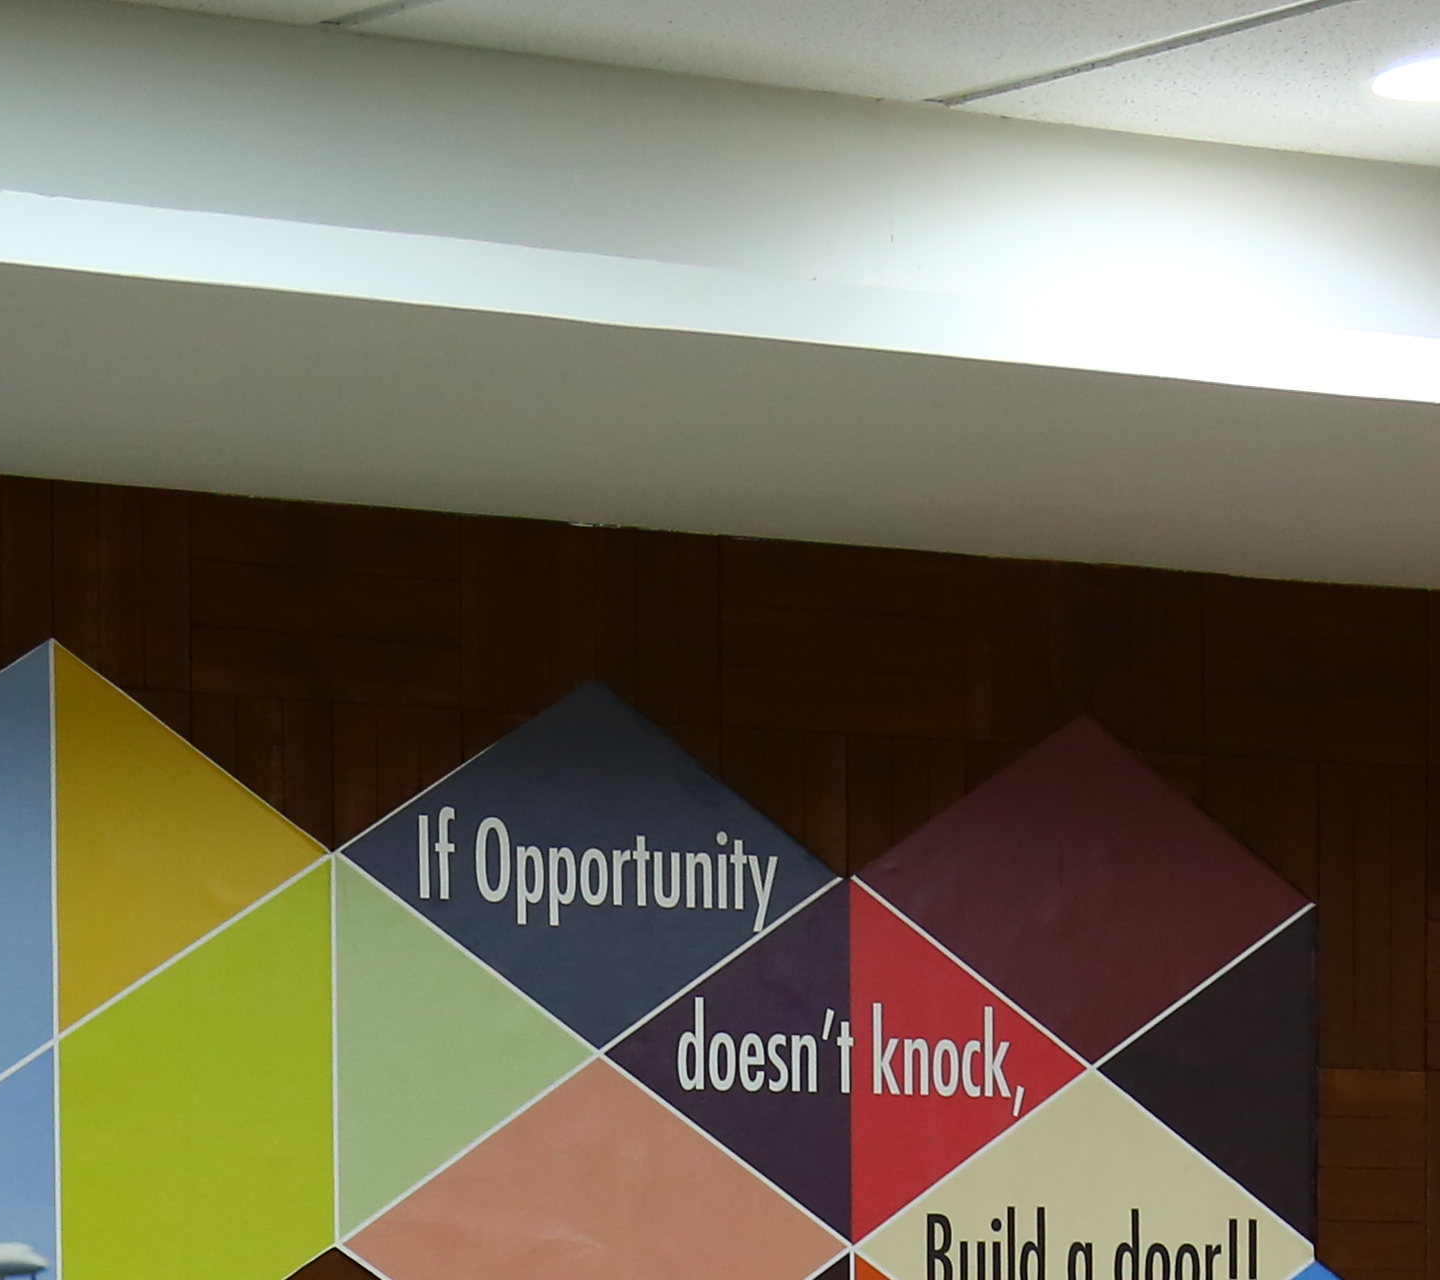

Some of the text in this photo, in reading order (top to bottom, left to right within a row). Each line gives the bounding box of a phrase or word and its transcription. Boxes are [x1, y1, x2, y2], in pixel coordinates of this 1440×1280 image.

[418, 806, 779, 932] If Opportunity
[677, 996, 1025, 1117] doesn't knock,
